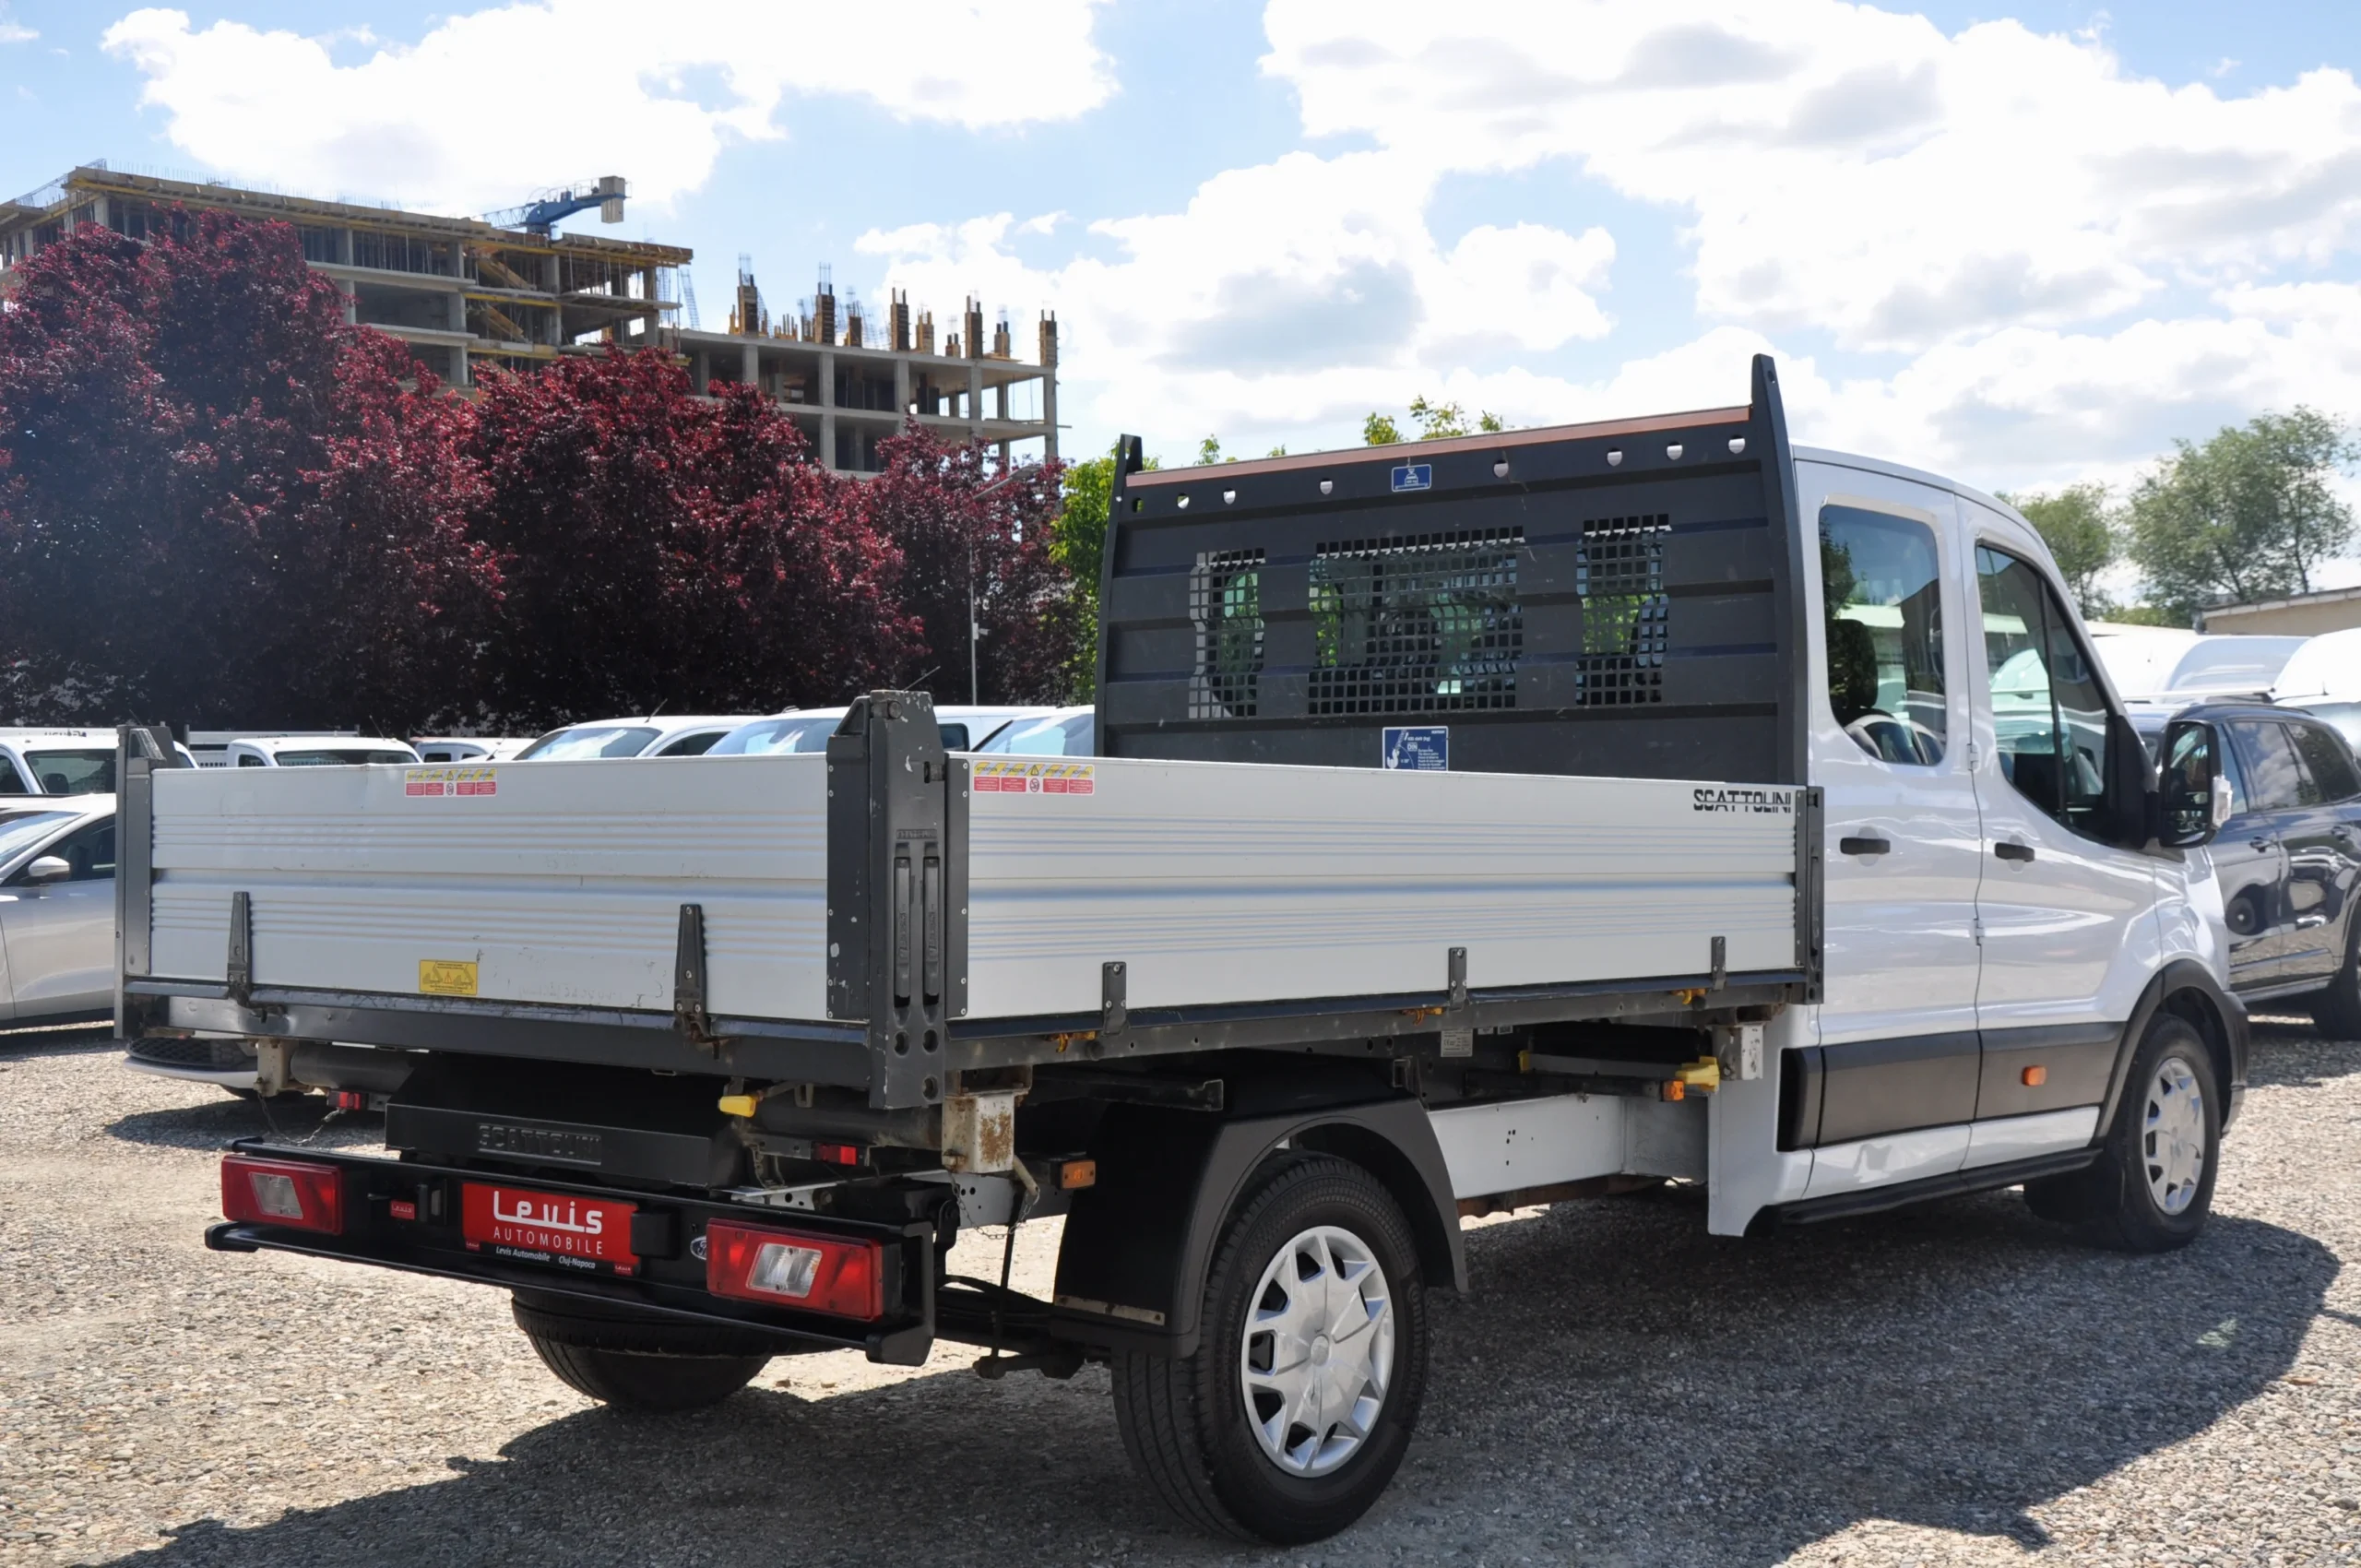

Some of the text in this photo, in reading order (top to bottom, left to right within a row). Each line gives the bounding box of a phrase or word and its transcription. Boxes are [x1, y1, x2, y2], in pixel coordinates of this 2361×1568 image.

[1693, 789, 1791, 814] SCATTOLINI
[493, 1190, 603, 1235] Levis
[493, 1226, 603, 1255] AUTOMOBILE
[495, 1245, 596, 1269] Levis Automobile Cluj-Napoca
